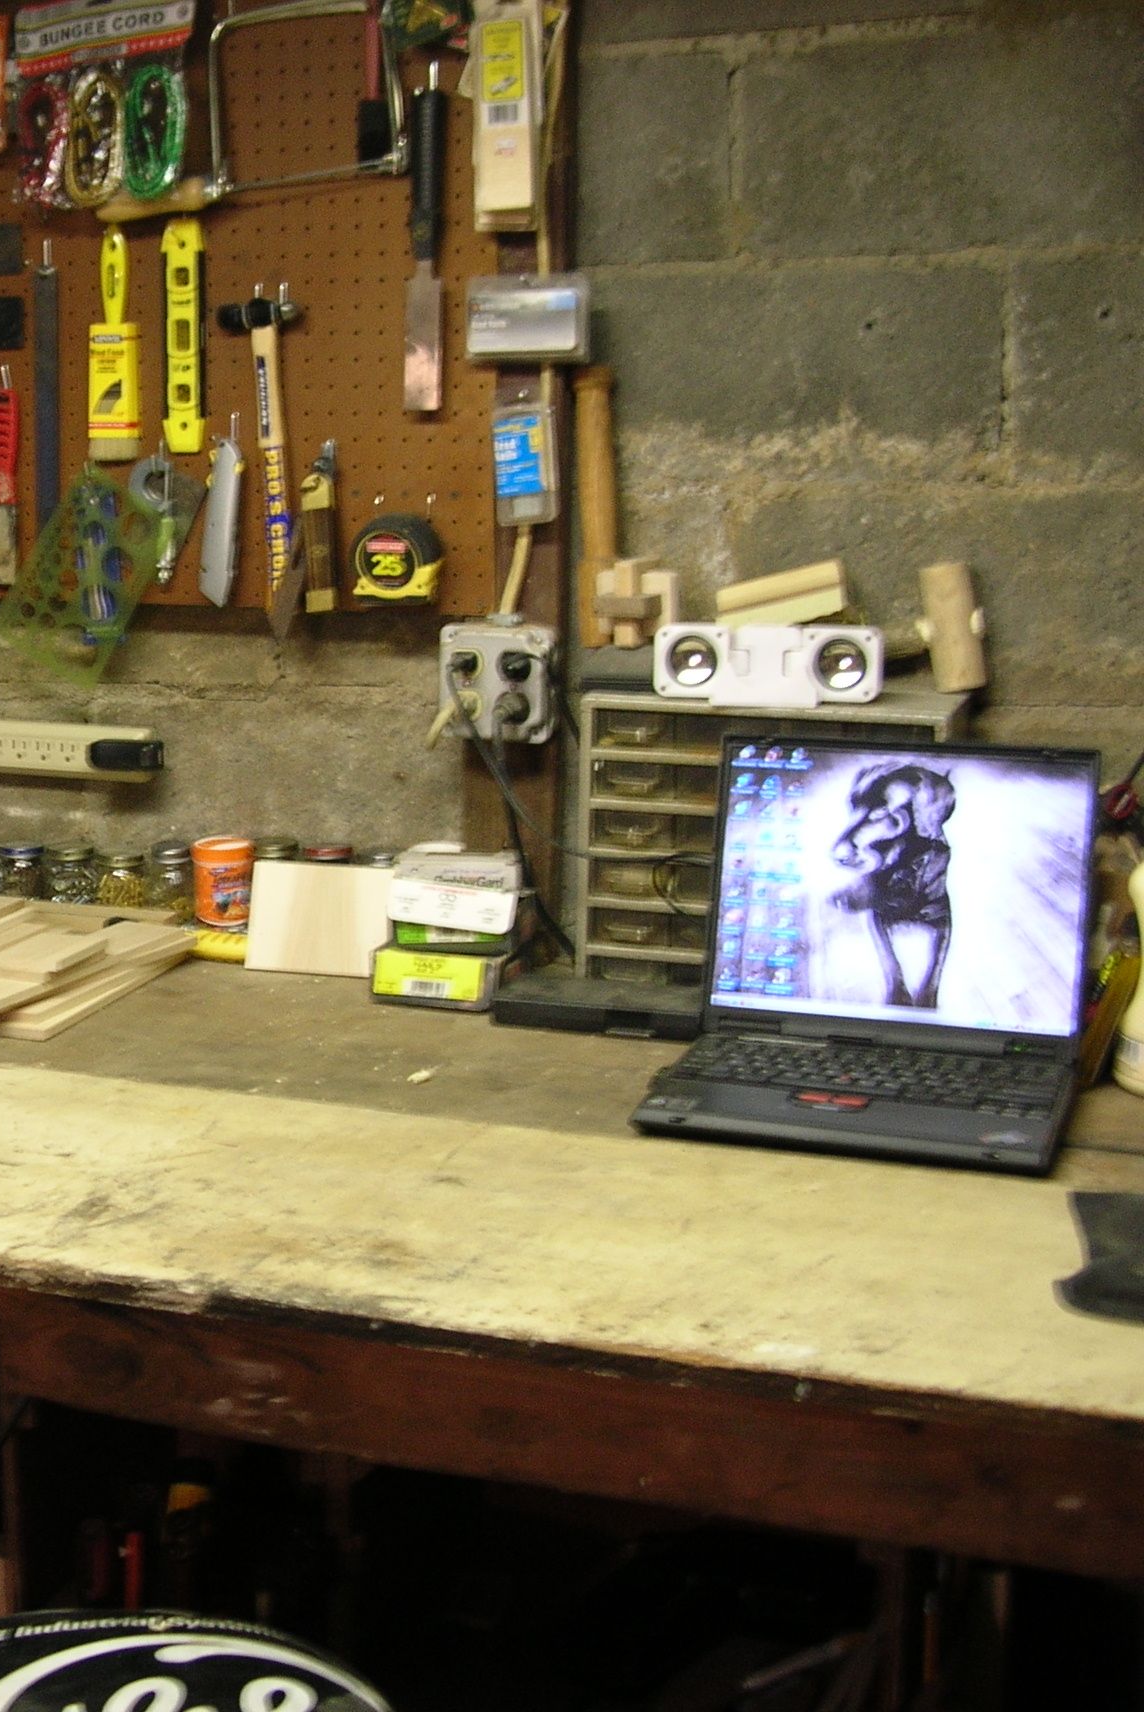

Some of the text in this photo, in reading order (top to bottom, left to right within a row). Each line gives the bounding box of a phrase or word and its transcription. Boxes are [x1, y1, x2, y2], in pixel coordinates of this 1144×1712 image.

[40, 11, 165, 47] BUNGEE CORD
[370, 553, 406, 577] 25
[14, 1615, 155, 1639] Industrial
